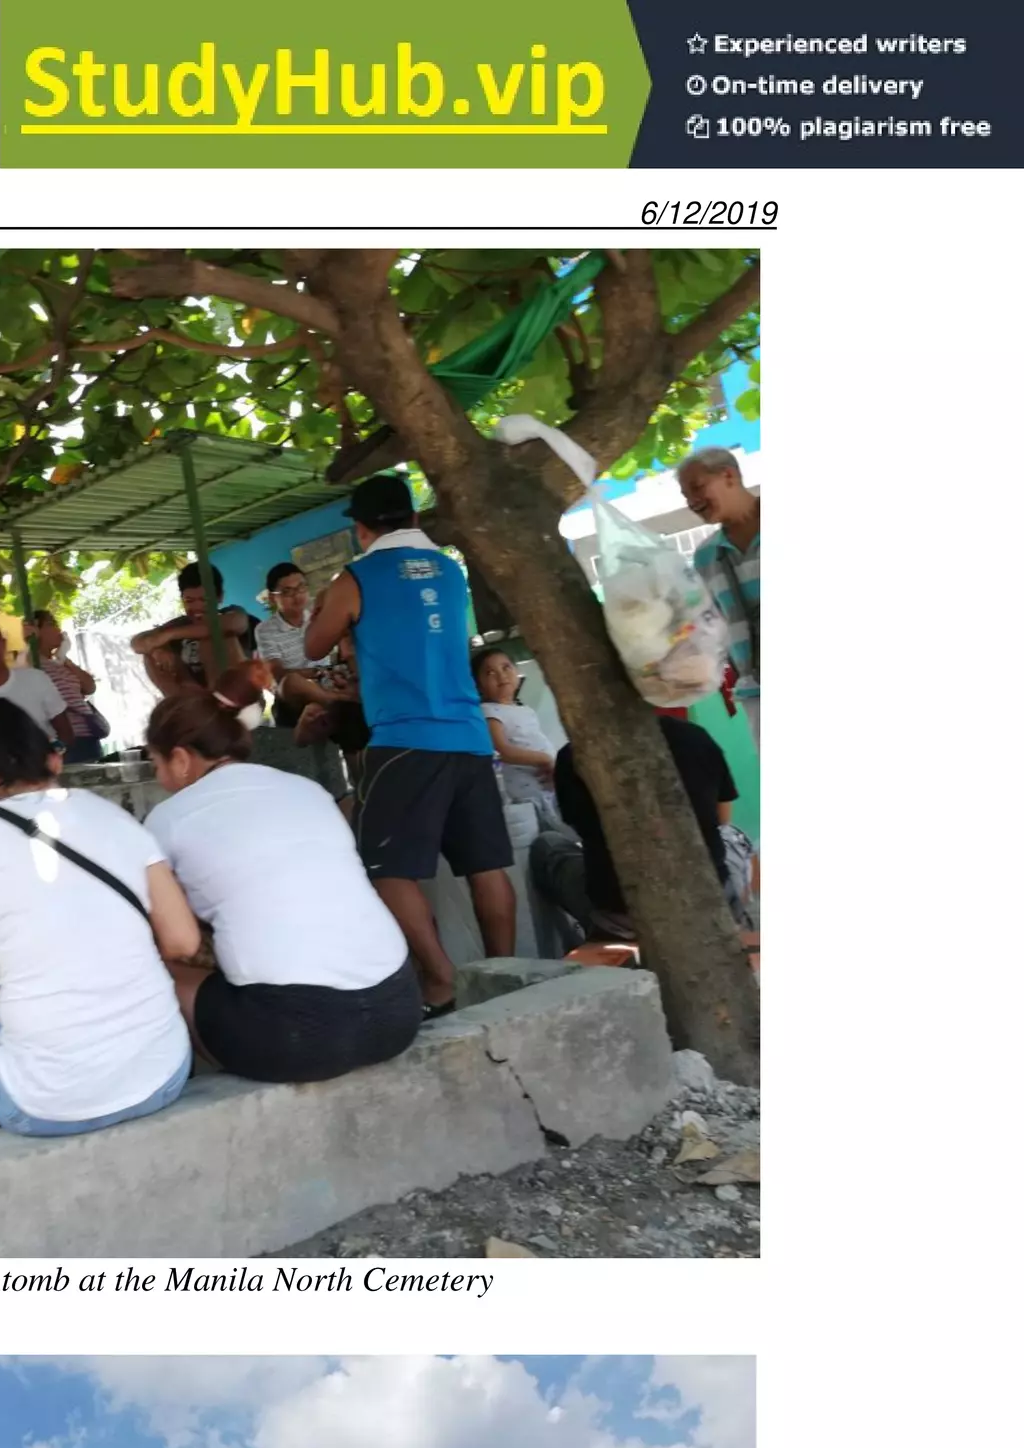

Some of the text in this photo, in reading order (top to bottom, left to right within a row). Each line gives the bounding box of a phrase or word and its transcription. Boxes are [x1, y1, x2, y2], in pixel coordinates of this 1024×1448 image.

[642, 201, 778, 225] 6/12/2019
[3, 1267, 70, 1292] tomb
[79, 1272, 107, 1292] at
[116, 1267, 156, 1292] the
[165, 1267, 264, 1292] Manila
[273, 1267, 353, 1292] North
[364, 1267, 494, 1299] Cemetery
